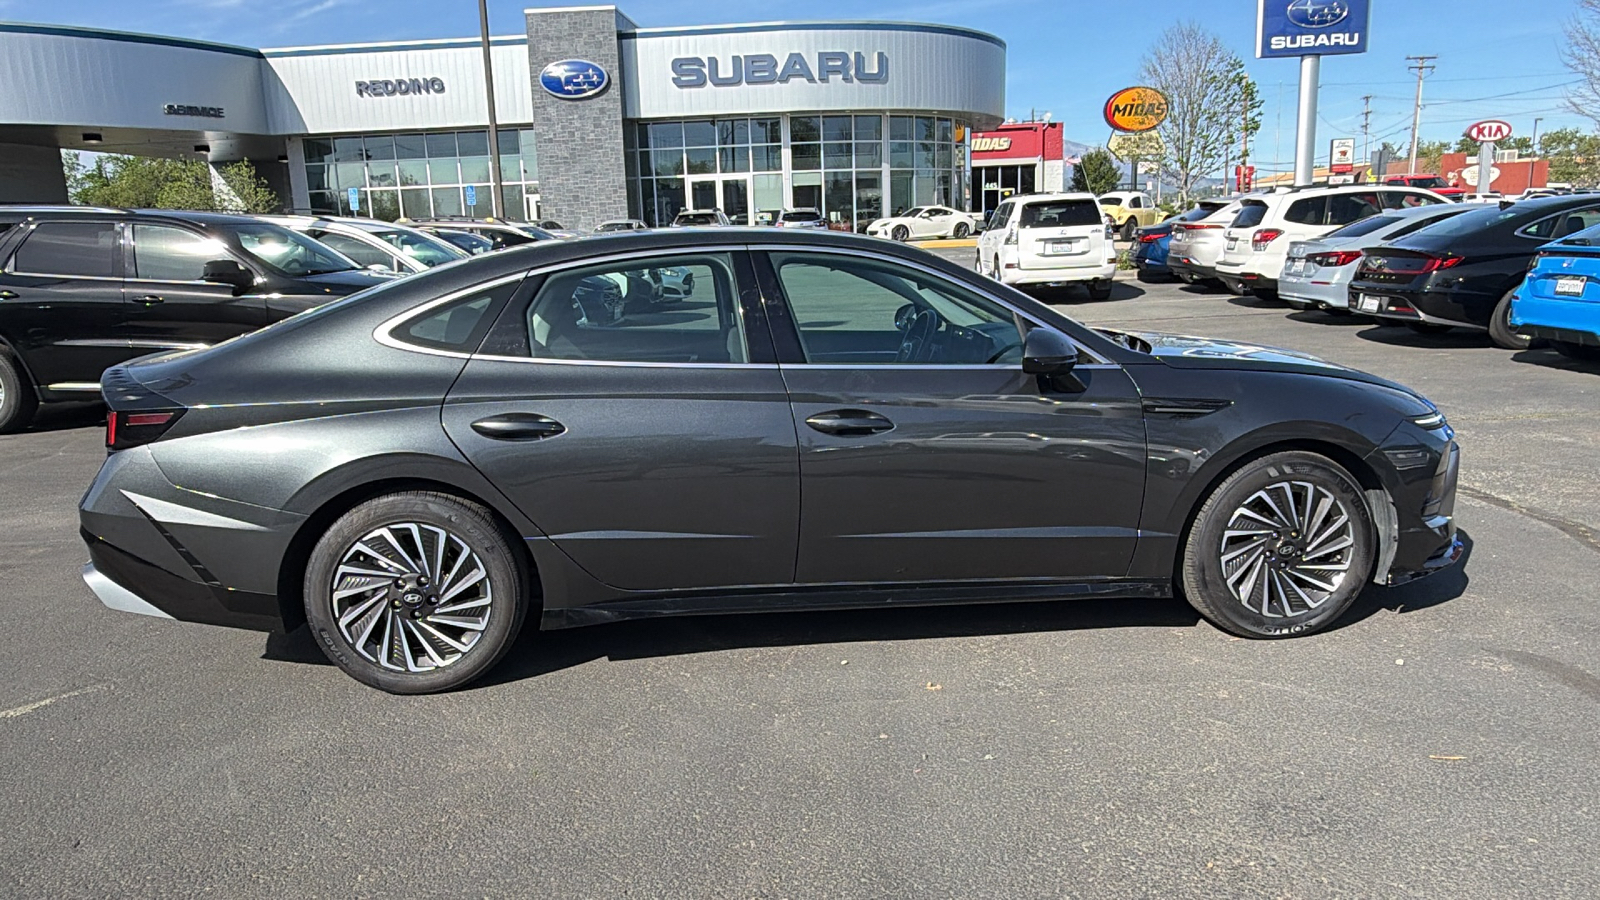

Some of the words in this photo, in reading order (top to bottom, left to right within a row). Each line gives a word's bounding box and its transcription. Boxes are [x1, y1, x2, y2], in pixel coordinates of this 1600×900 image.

[1270, 32, 1359, 50] SUBARU
[671, 51, 889, 89] SUBARU
[355, 77, 445, 98] REDDING
[1476, 125, 1504, 139] KIA
